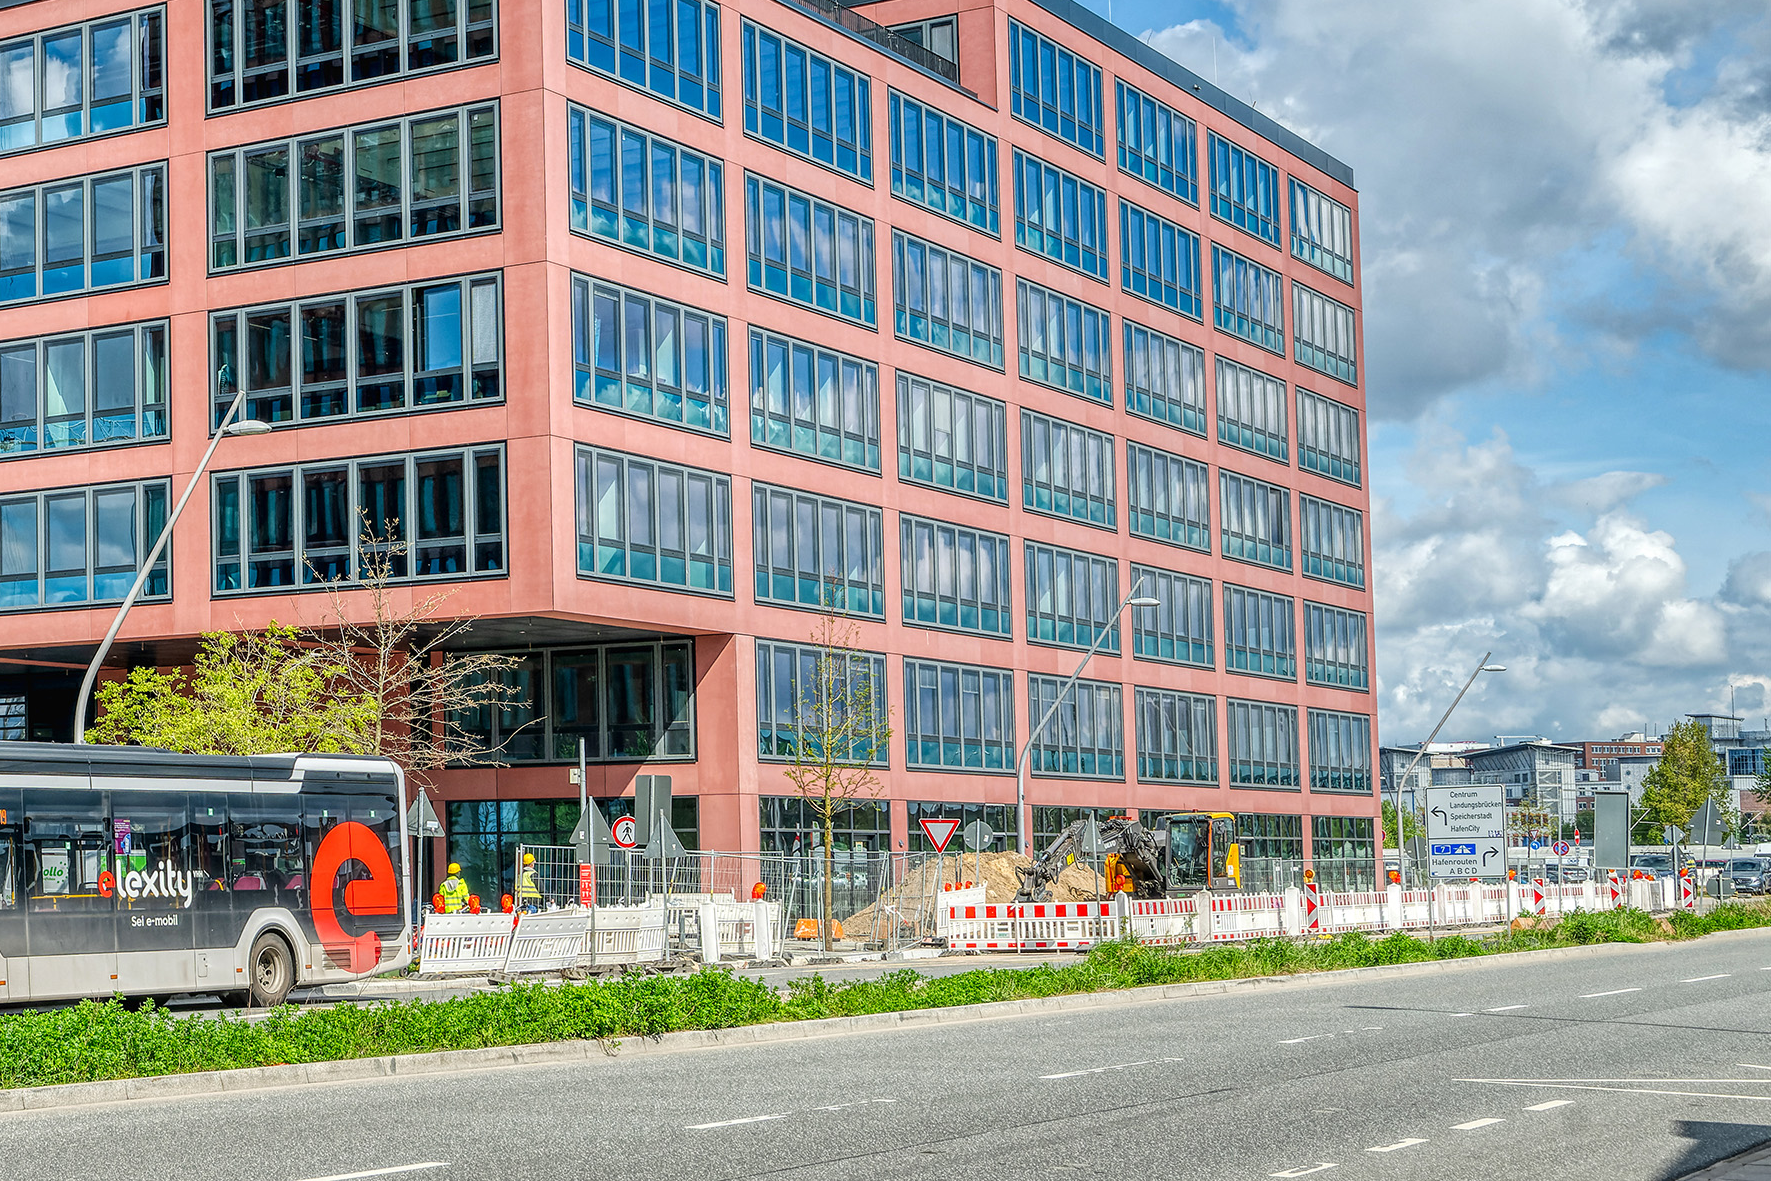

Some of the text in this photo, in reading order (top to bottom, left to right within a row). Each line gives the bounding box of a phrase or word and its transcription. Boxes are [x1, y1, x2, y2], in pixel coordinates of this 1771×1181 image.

[1450, 801, 1502, 810] Landungsbrücken
[1450, 813, 1493, 821] Speicherstadt
[1450, 825, 1480, 833] HafenCity
[98, 859, 192, 909] elexity
[131, 914, 178, 927] Sei e-mobil
